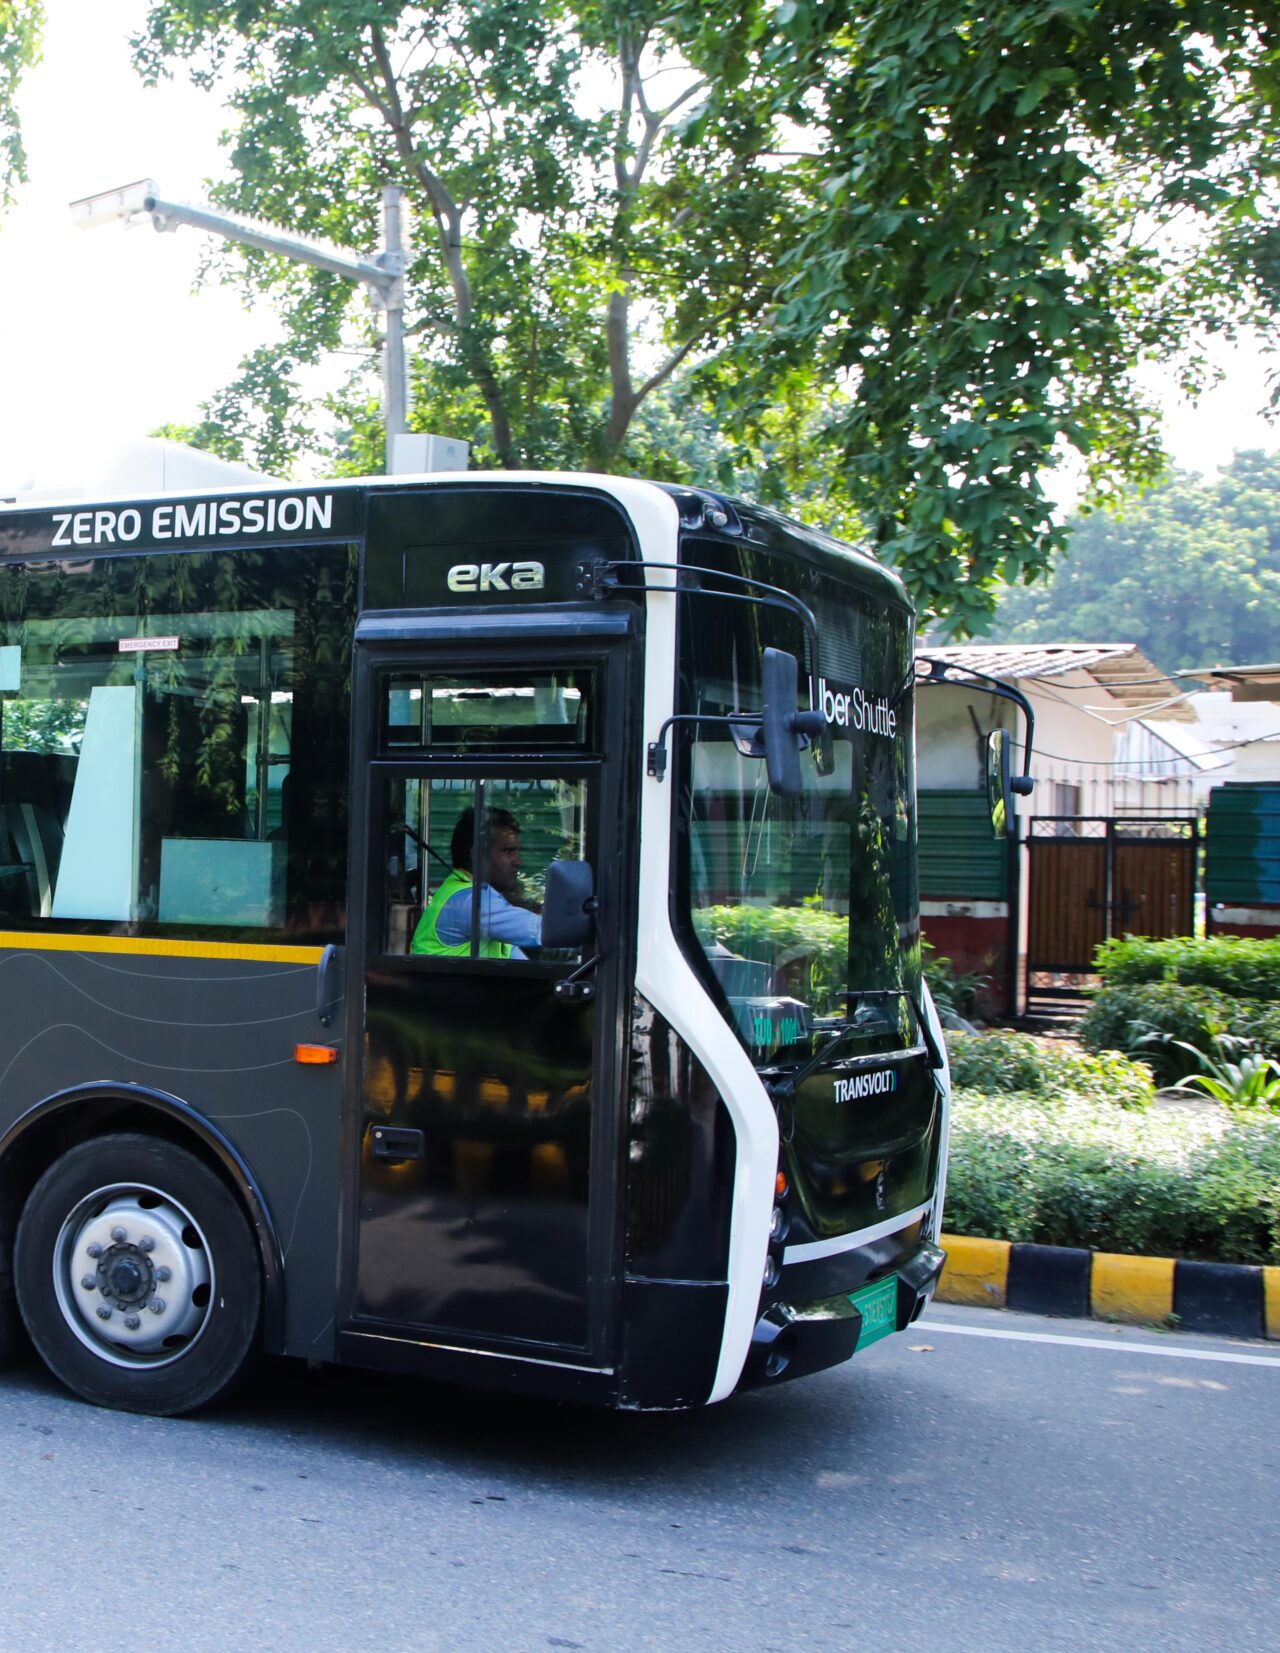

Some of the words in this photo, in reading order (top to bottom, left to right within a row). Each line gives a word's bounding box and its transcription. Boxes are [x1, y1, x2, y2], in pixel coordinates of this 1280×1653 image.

[51, 509, 142, 547] ZERO
[151, 495, 333, 539] EMISSION
[120, 640, 160, 650] EMERGENCY
[162, 639, 177, 648] EXIT
[809, 675, 851, 727] Uber
[853, 687, 896, 738] Shuttle
[833, 1069, 891, 1104] TRANSVOLT
